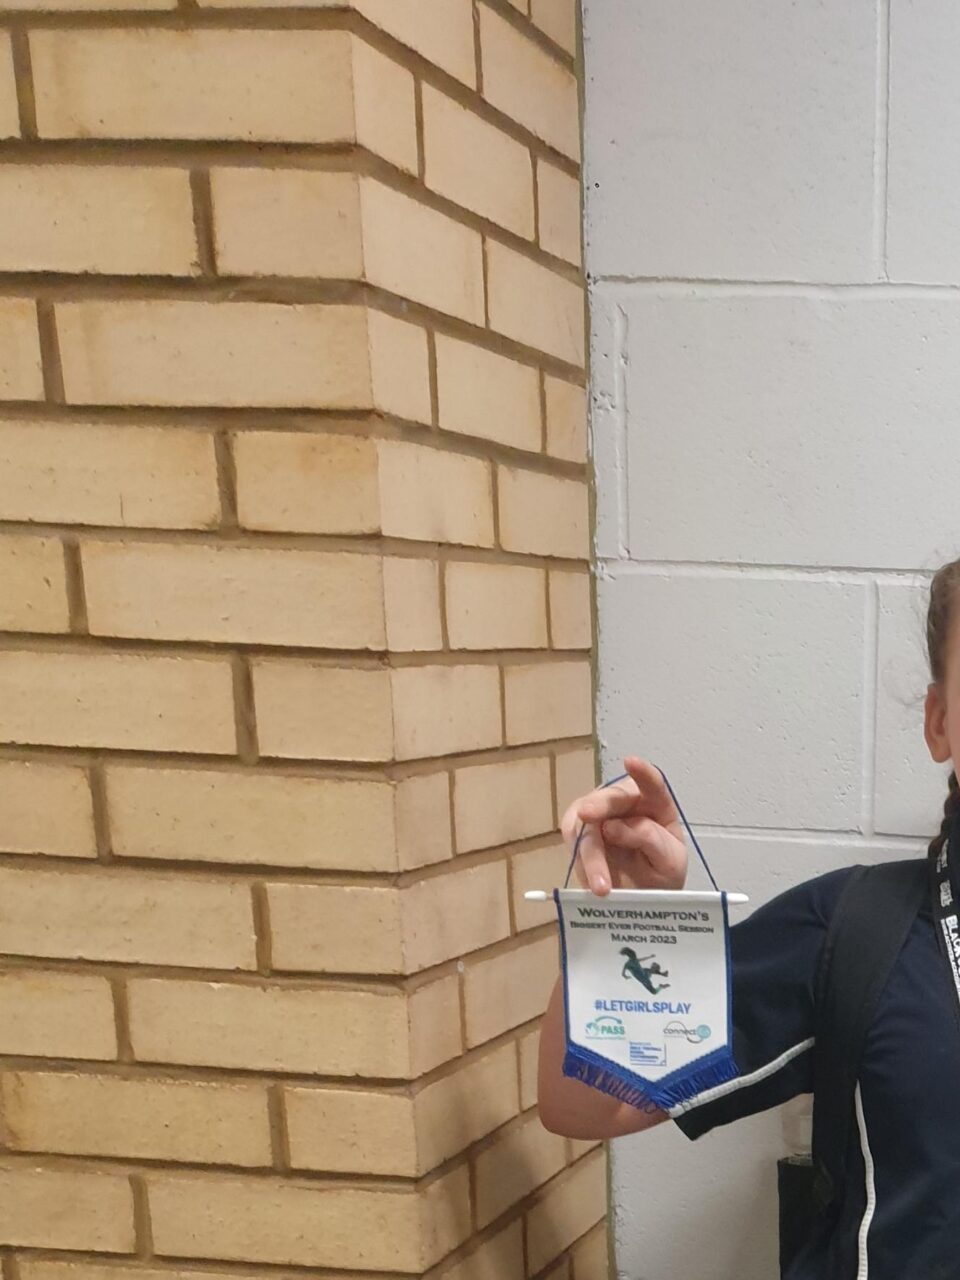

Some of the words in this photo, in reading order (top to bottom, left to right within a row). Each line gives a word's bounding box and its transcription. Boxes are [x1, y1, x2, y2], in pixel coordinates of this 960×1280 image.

[577, 907, 709, 921] WOLVERHAMPTON'S
[633, 923, 677, 932] FOOTBALL
[611, 933, 648, 943] MARCH
[650, 935, 677, 944] 2023
[601, 1025, 625, 1035] PASS
